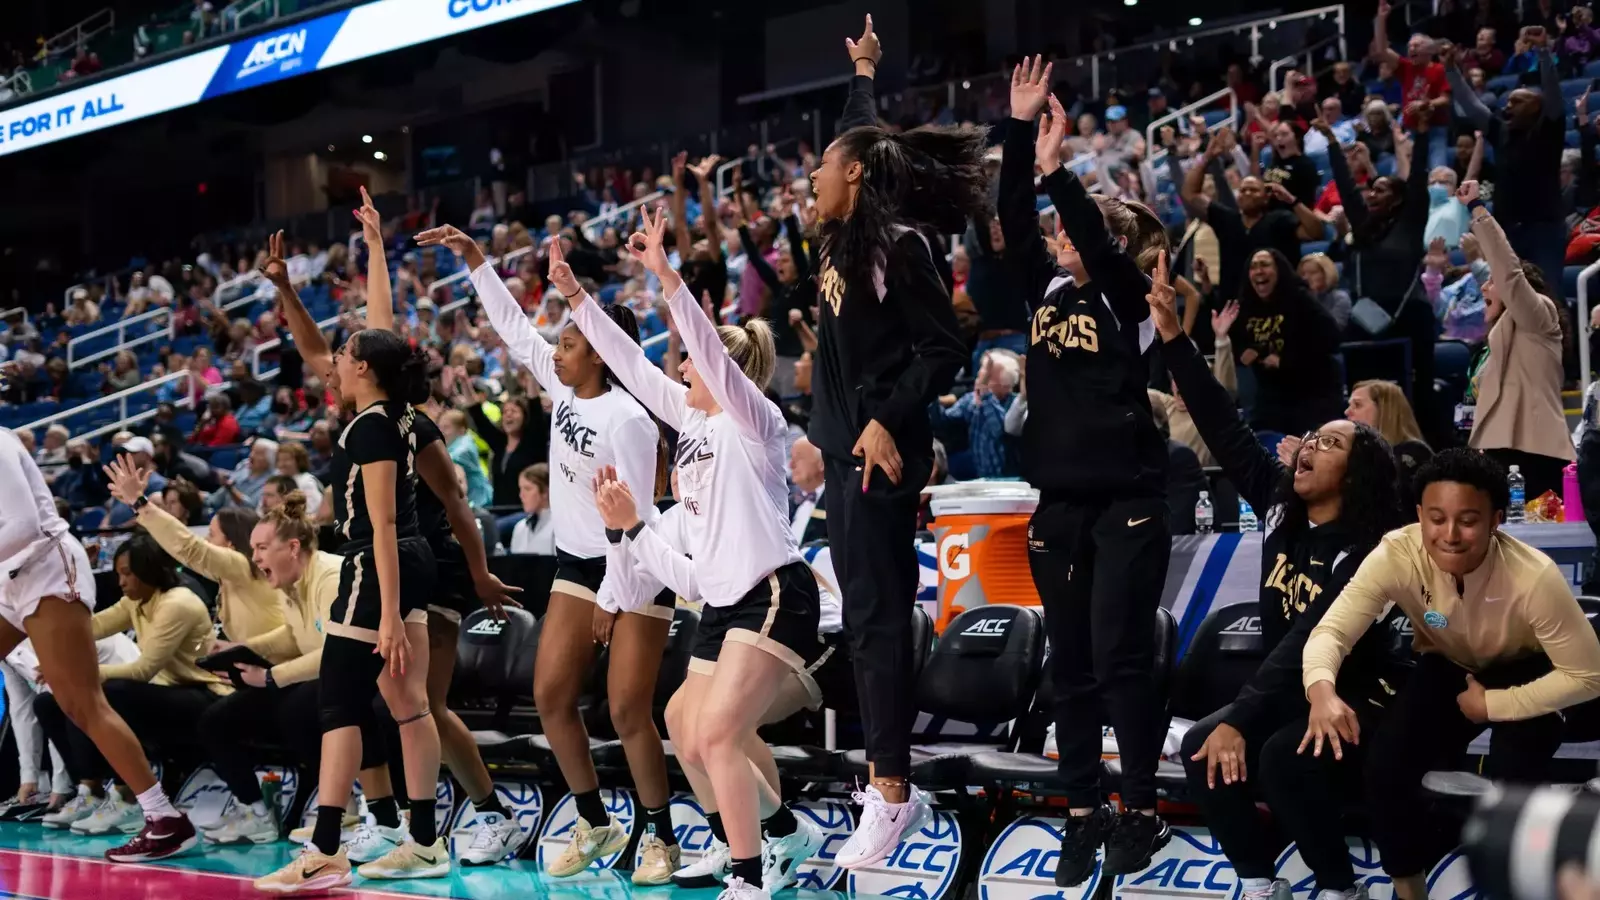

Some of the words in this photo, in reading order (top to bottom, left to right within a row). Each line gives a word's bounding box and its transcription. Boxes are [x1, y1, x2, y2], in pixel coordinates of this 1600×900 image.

[243, 28, 307, 68] ACCN
[10, 112, 51, 140] FOR
[57, 105, 75, 127] IT
[82, 93, 124, 120] ALL
[1031, 305, 1099, 353] DEACS
[555, 400, 597, 459] WAKE
[940, 532, 970, 580] G
[964, 618, 1011, 633] ACC
[1223, 616, 1262, 631] AC
[1391, 616, 1414, 632] AC
[995, 848, 1062, 878] AC
[1130, 858, 1234, 891] ACC
